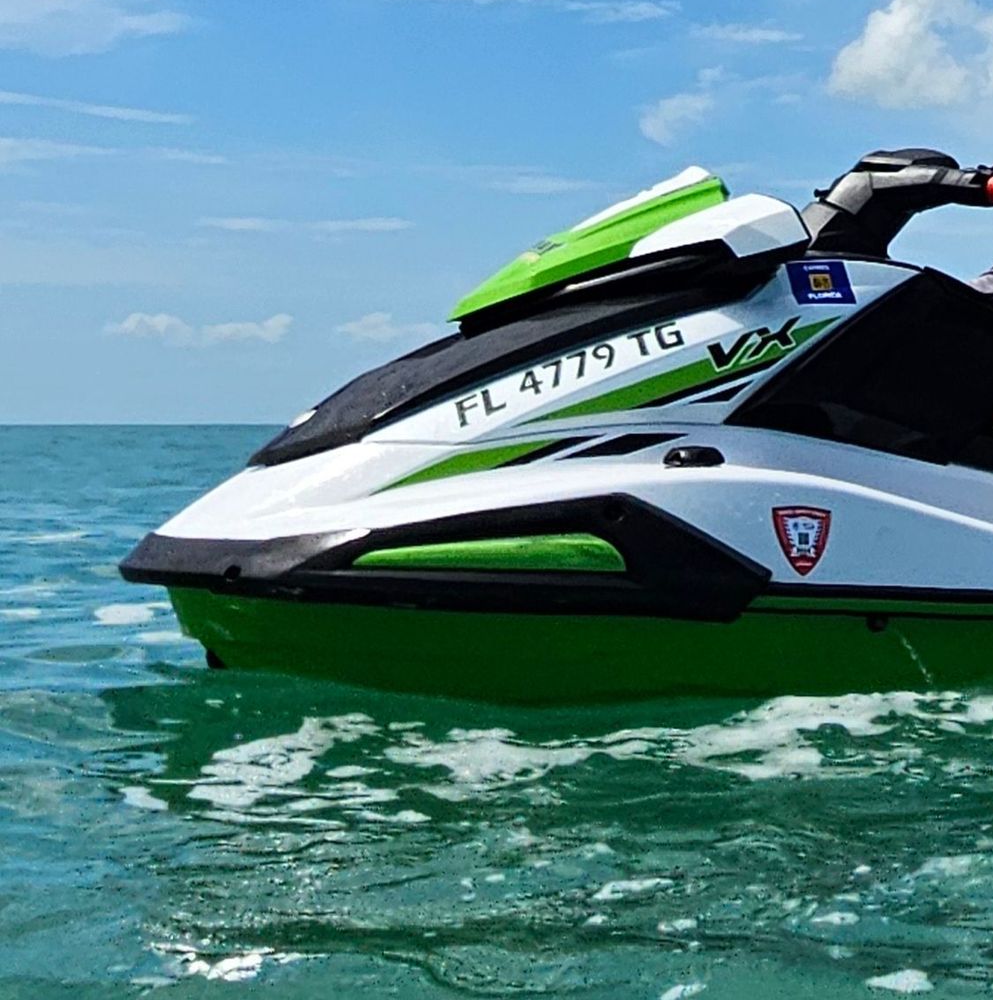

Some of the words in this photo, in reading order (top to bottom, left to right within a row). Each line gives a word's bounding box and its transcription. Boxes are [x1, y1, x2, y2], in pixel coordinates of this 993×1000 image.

[453, 388, 507, 427] FL
[519, 343, 615, 395] 4779
[626, 322, 685, 356] TG
[707, 315, 802, 373] VX
